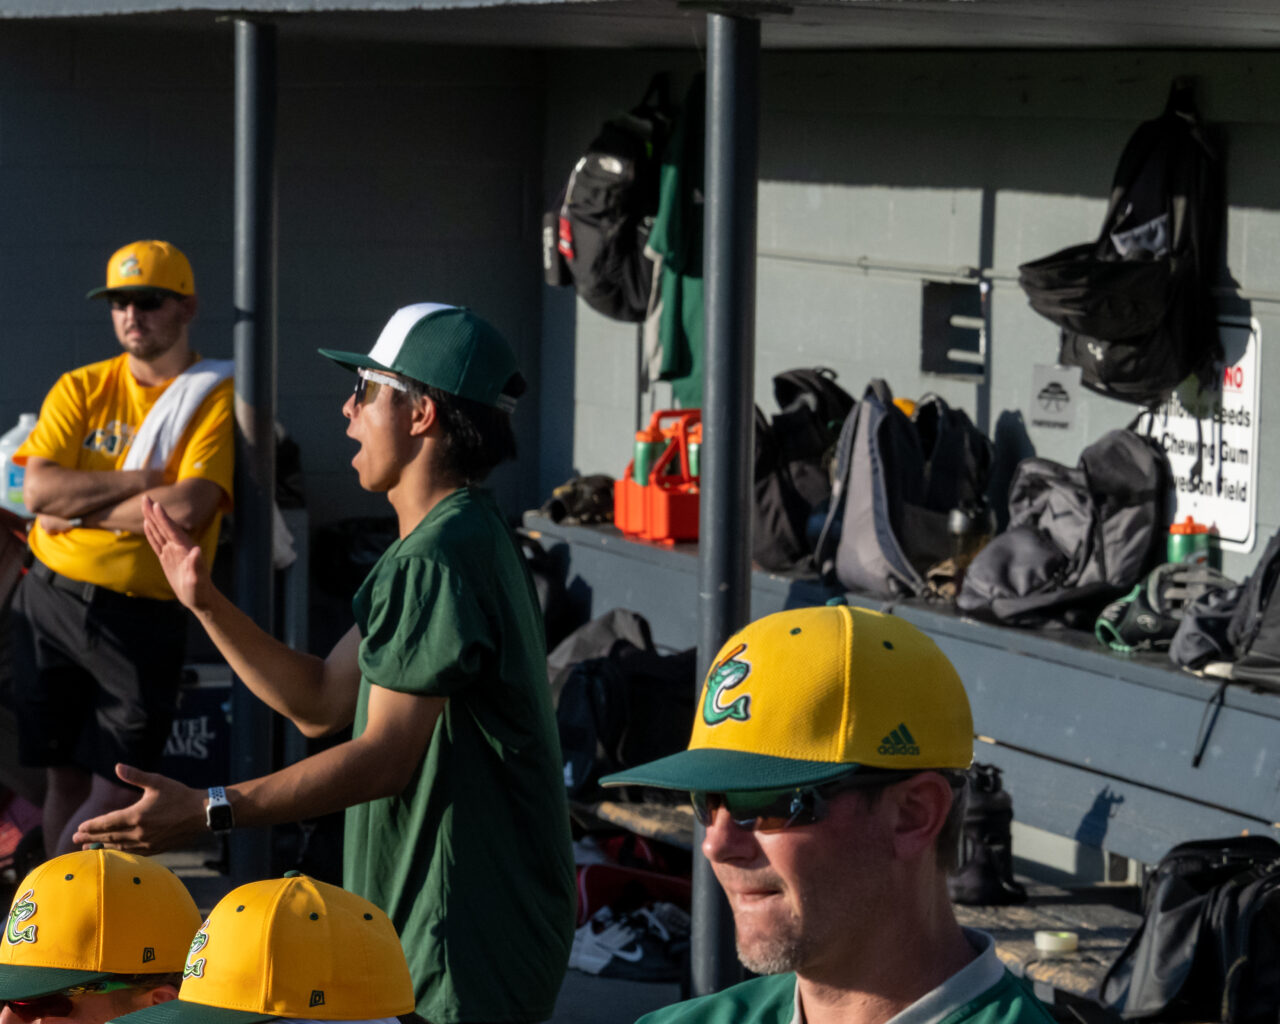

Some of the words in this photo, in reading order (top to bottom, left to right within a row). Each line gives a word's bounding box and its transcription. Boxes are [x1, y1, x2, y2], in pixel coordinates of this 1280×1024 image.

[1224, 367, 1244, 389] NO
[1161, 431, 1215, 466] Chewng
[1221, 440, 1249, 465] Gum
